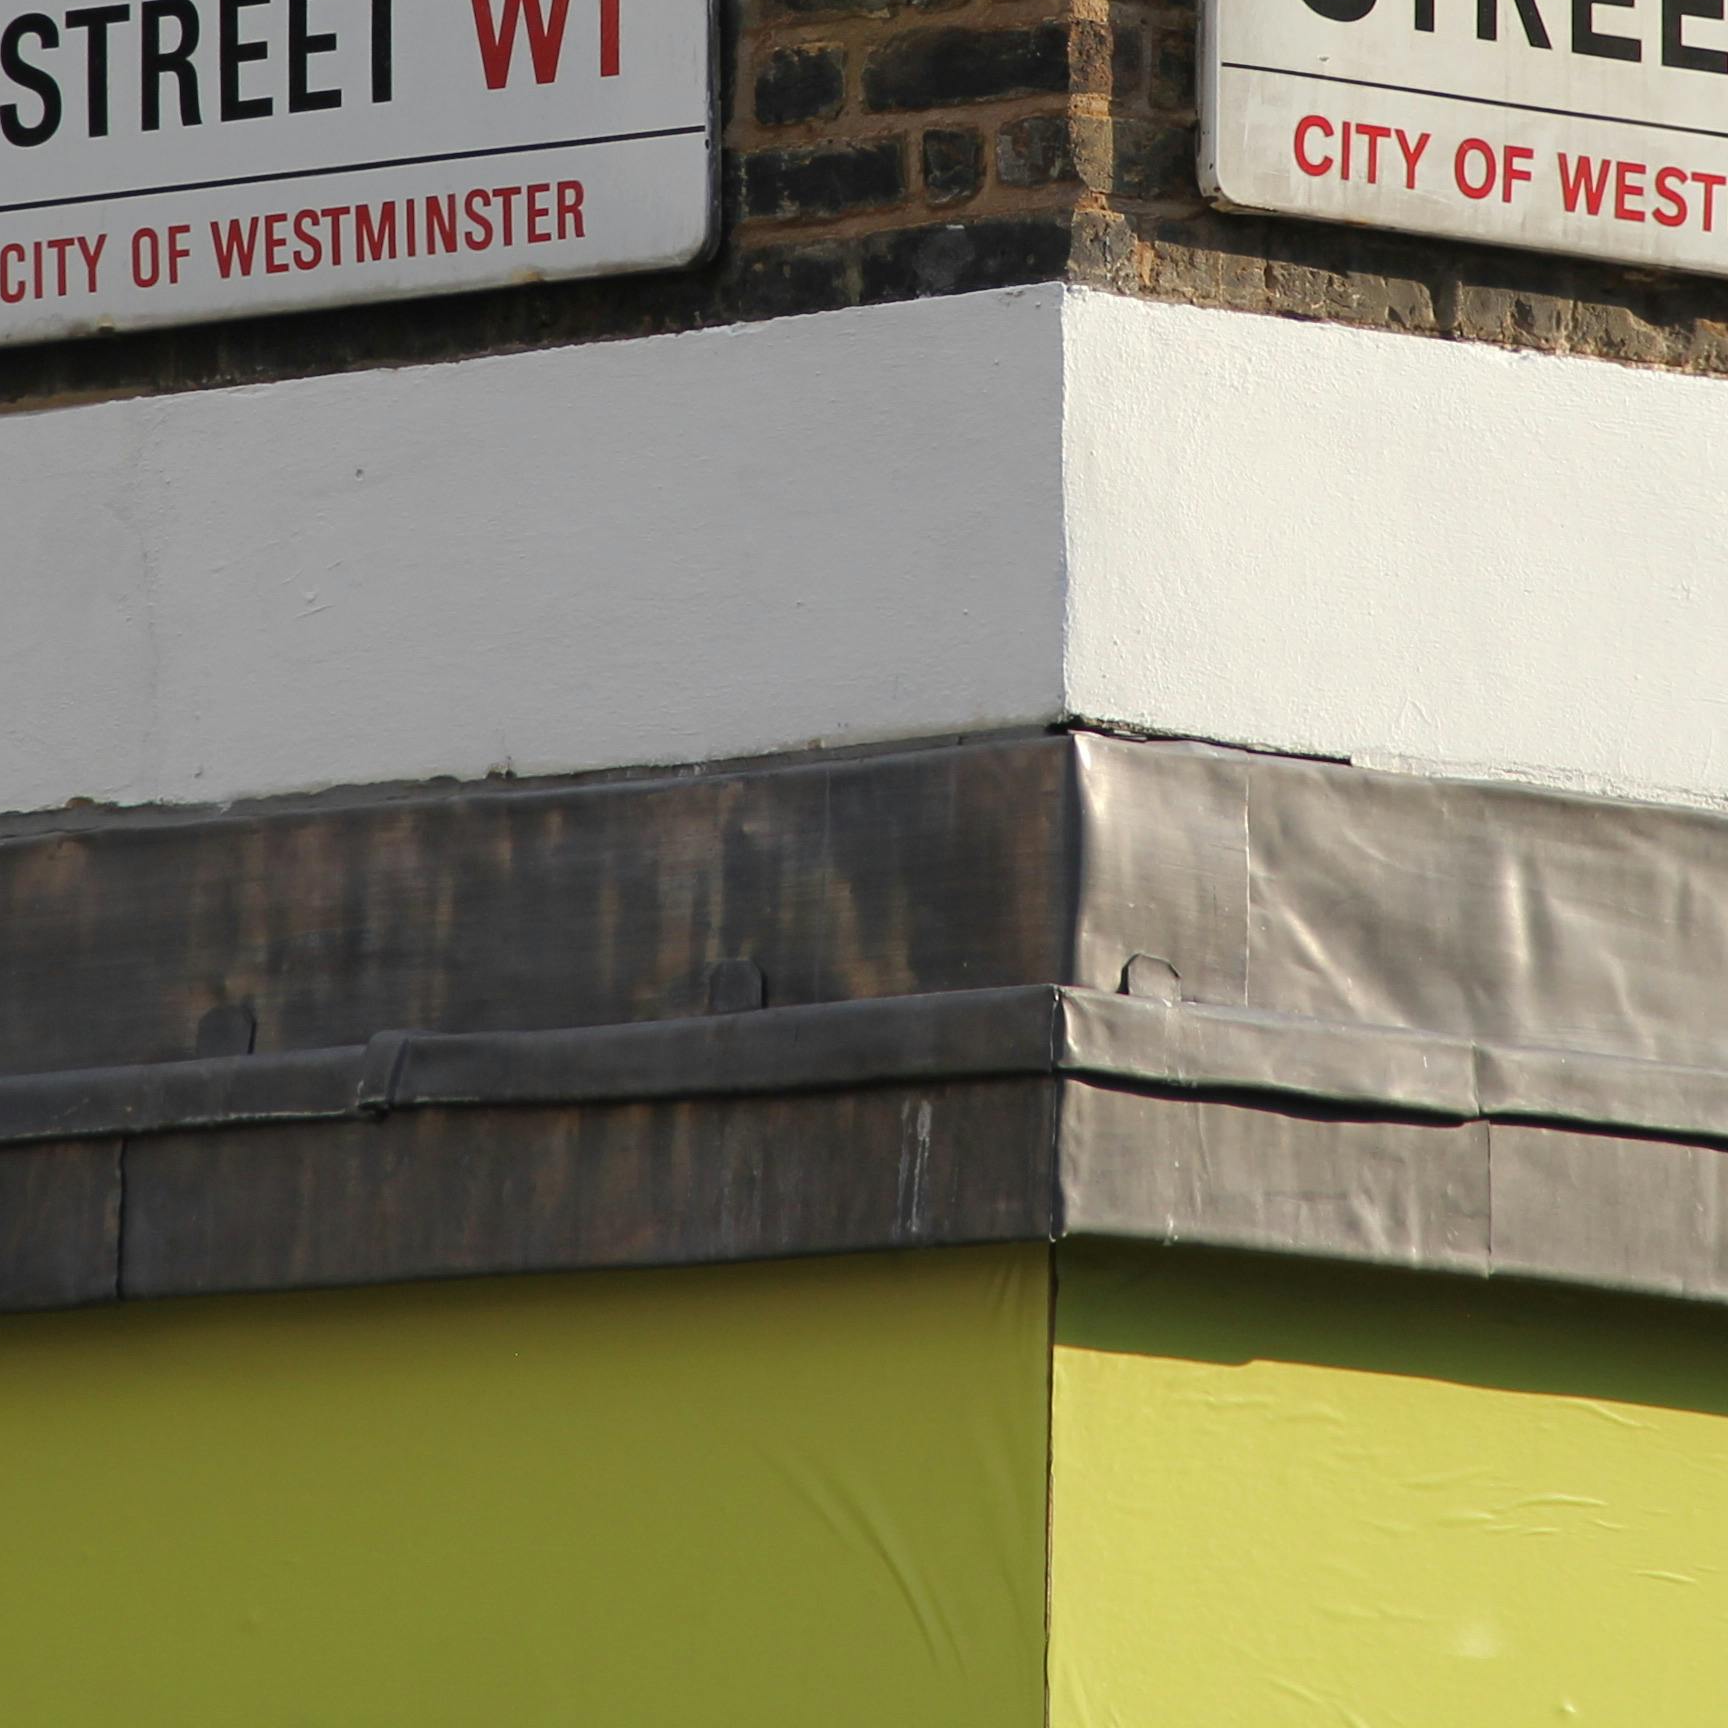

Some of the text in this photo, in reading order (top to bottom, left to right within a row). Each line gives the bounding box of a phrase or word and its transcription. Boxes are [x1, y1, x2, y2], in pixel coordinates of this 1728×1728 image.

[1293, 114, 1432, 190] CITY
[1454, 137, 1535, 203] OF
[131, 225, 192, 289] OF
[210, 179, 586, 280] WESTMINSTER
